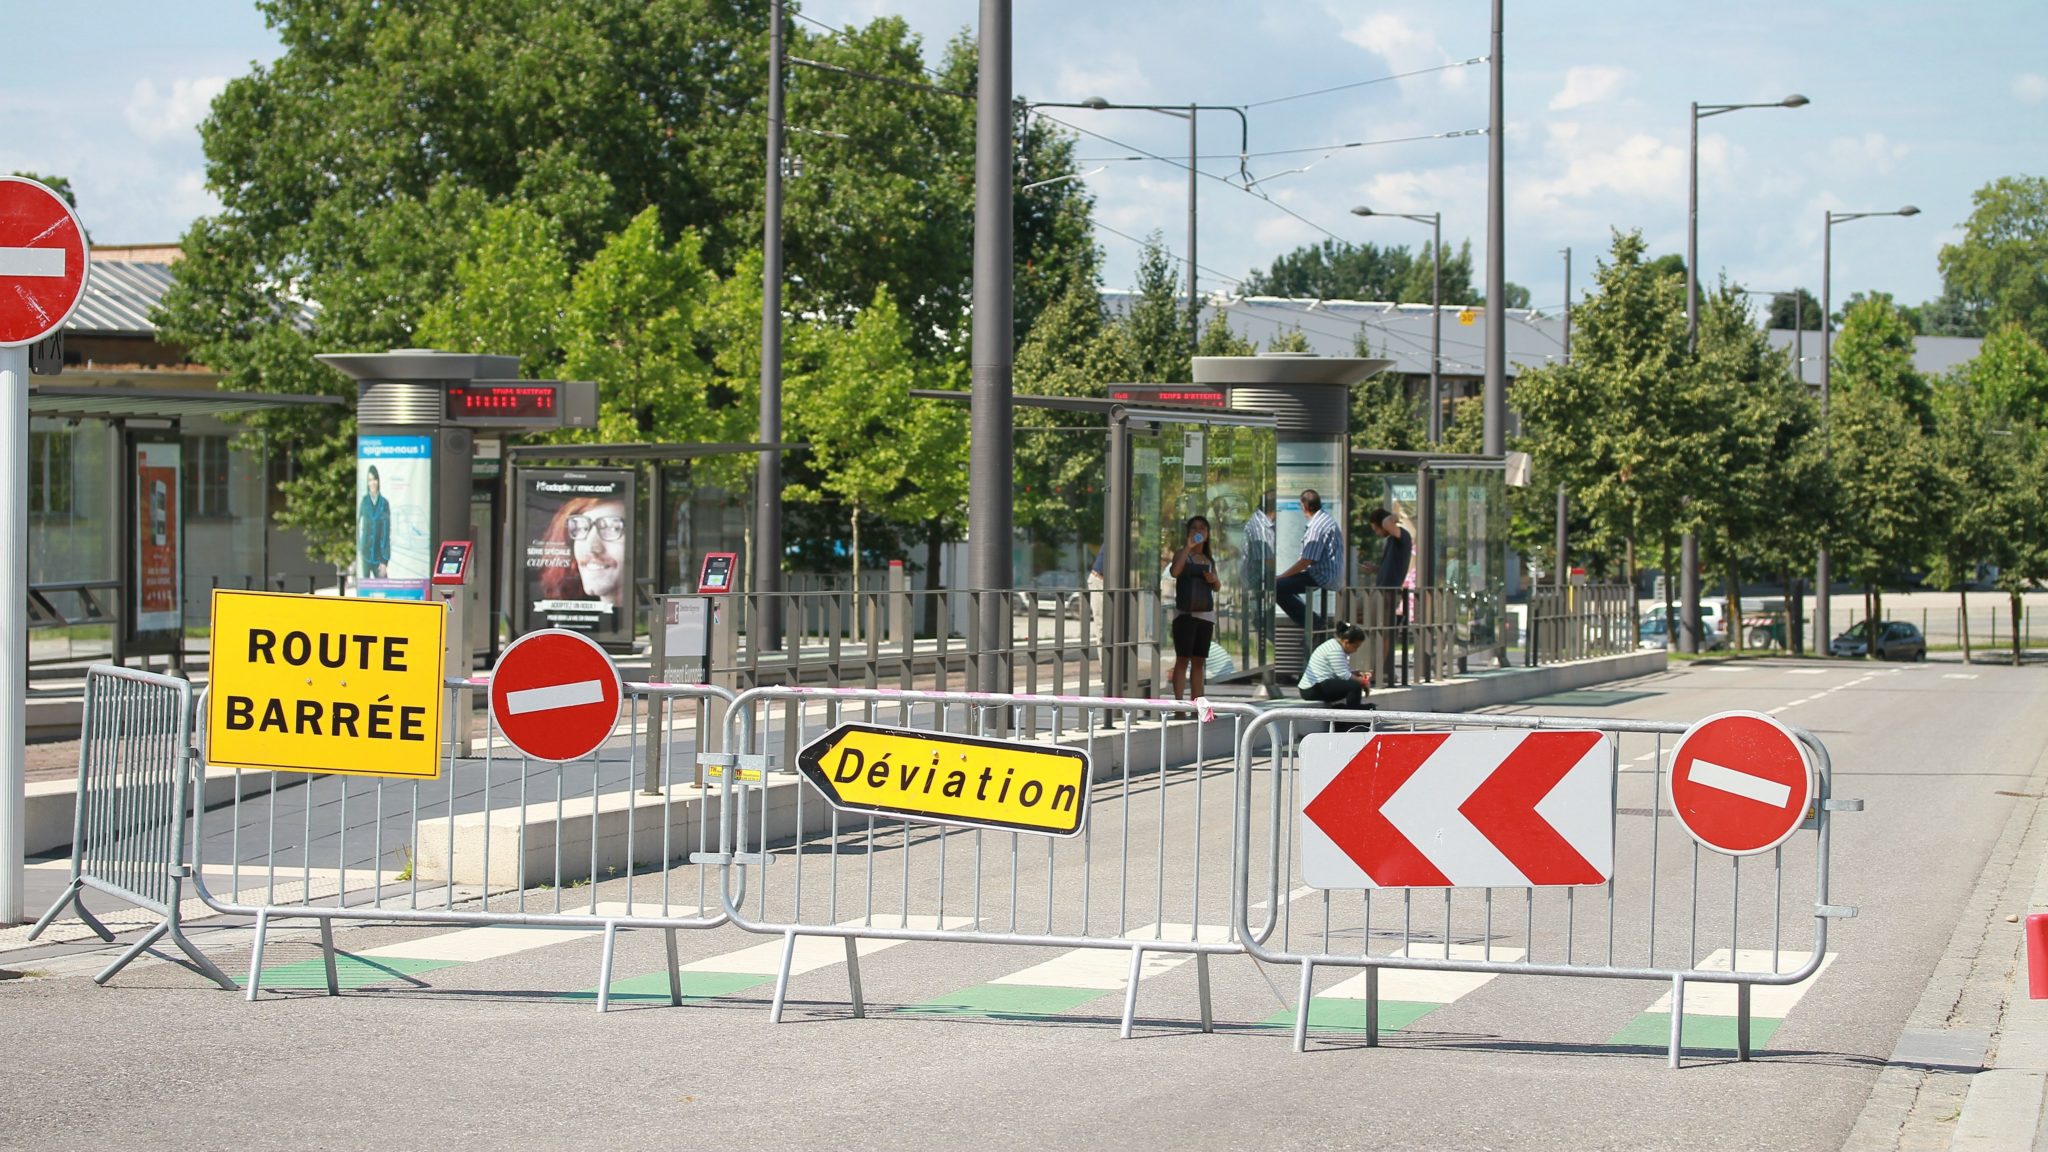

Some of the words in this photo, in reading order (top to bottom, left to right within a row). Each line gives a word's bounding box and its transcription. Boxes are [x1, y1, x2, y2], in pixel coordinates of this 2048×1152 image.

[248, 628, 409, 672] ROUTE
[225, 693, 426, 742] BARRÉE
[833, 746, 1077, 812] Déviation
